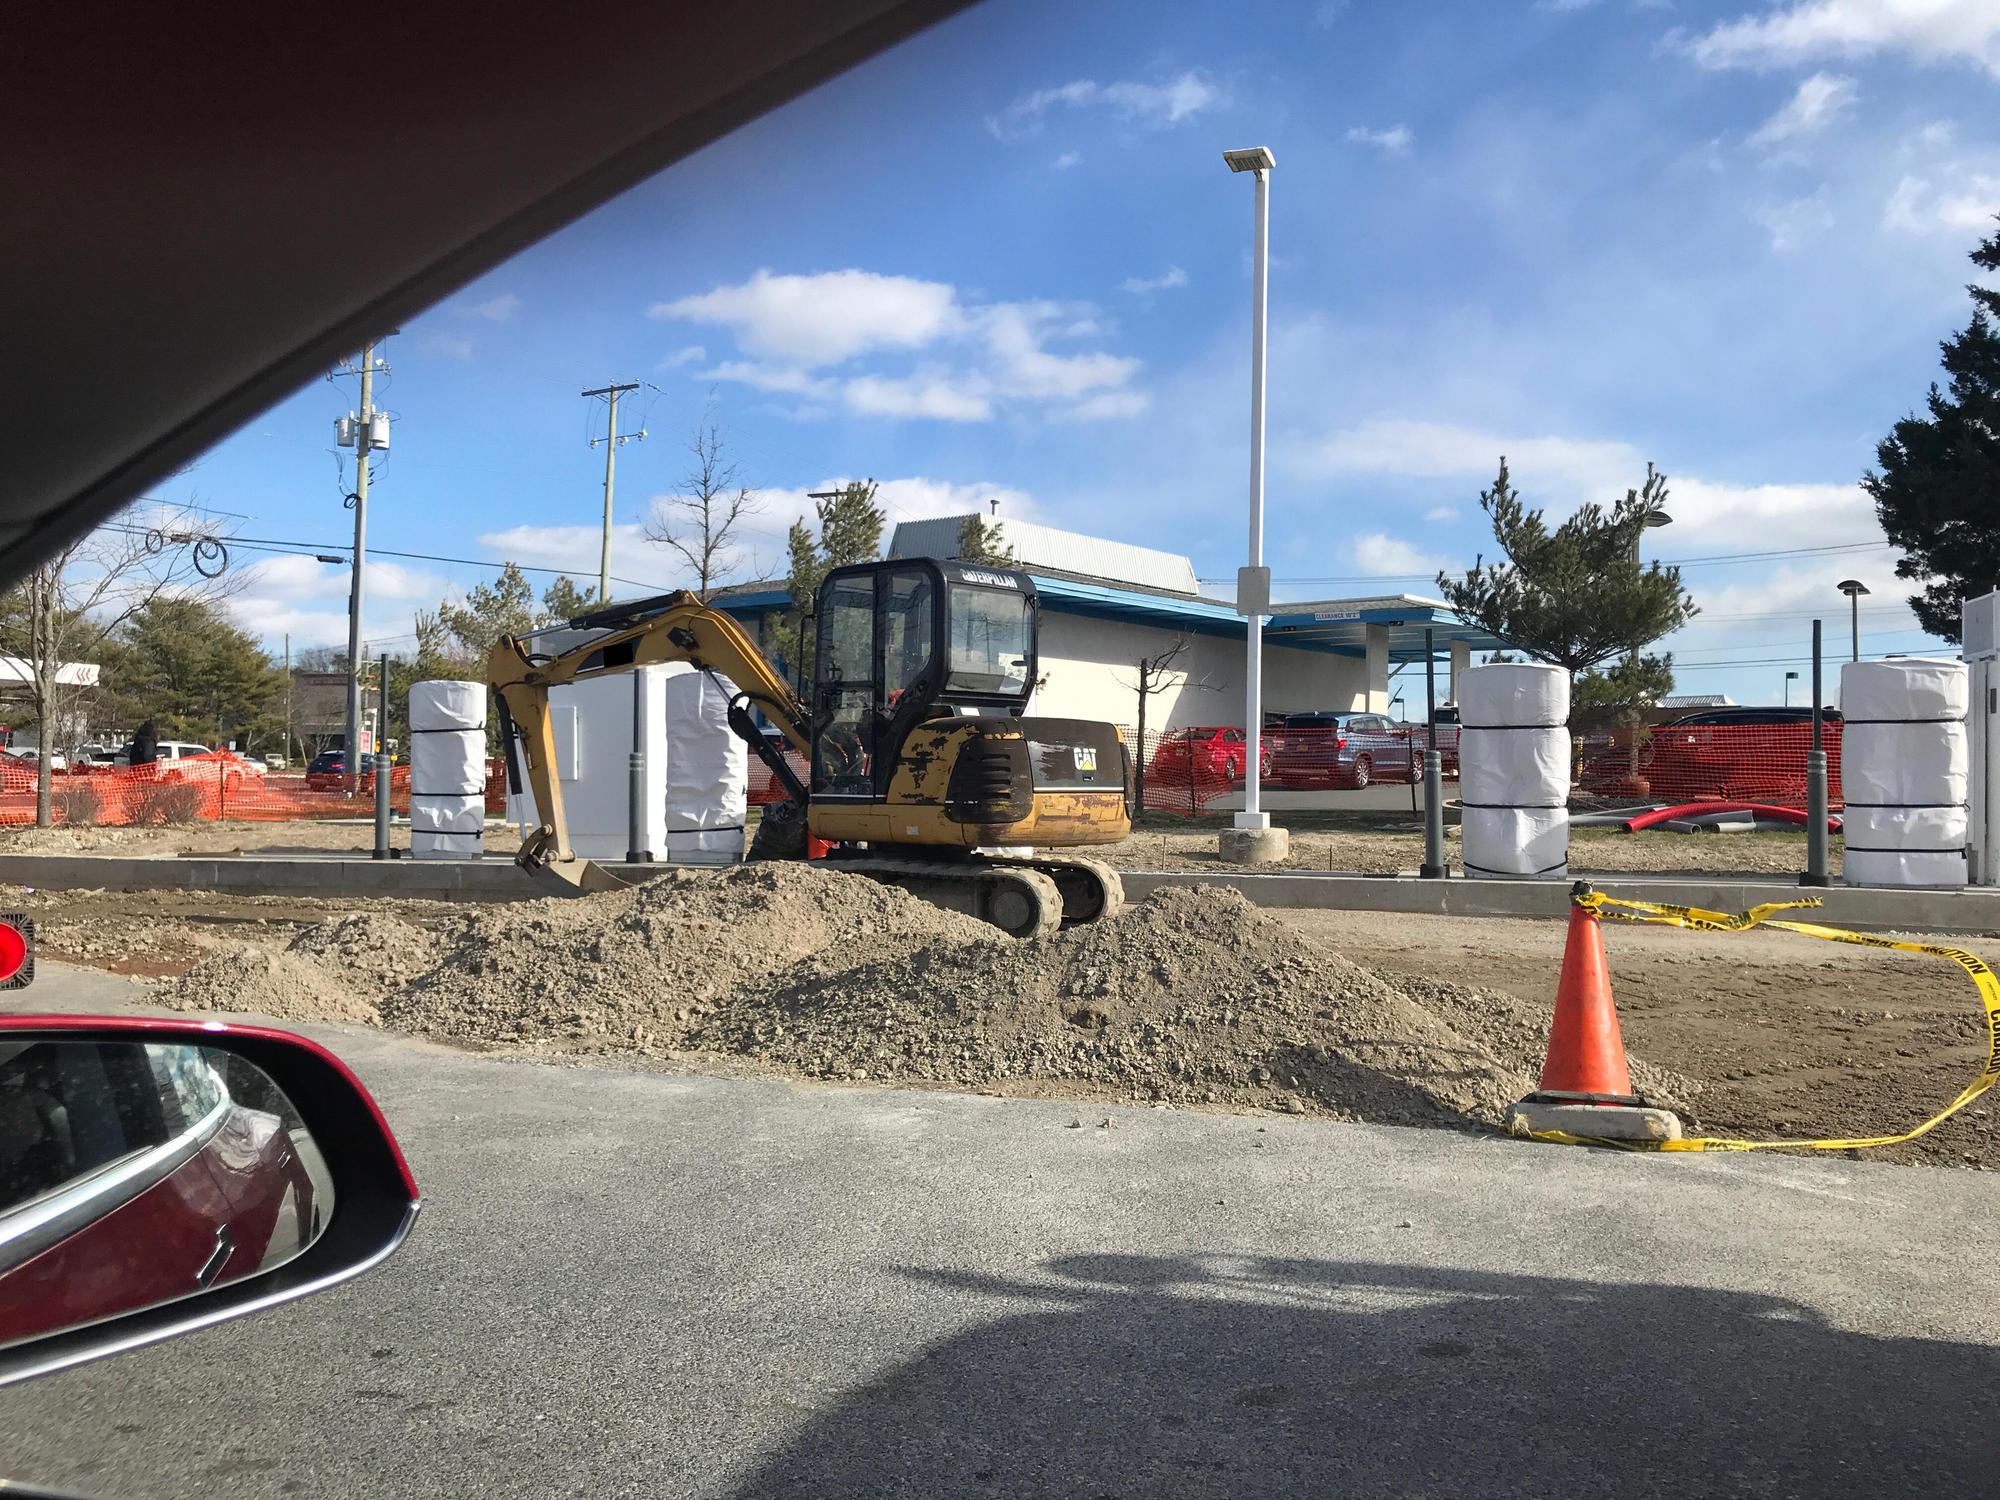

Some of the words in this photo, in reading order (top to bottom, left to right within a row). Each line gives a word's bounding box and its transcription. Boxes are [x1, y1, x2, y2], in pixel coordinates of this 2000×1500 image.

[960, 569, 1018, 589] CATERPILLAR
[1316, 612, 1345, 620] CLEARANCE
[1073, 747, 1097, 771] CAT
